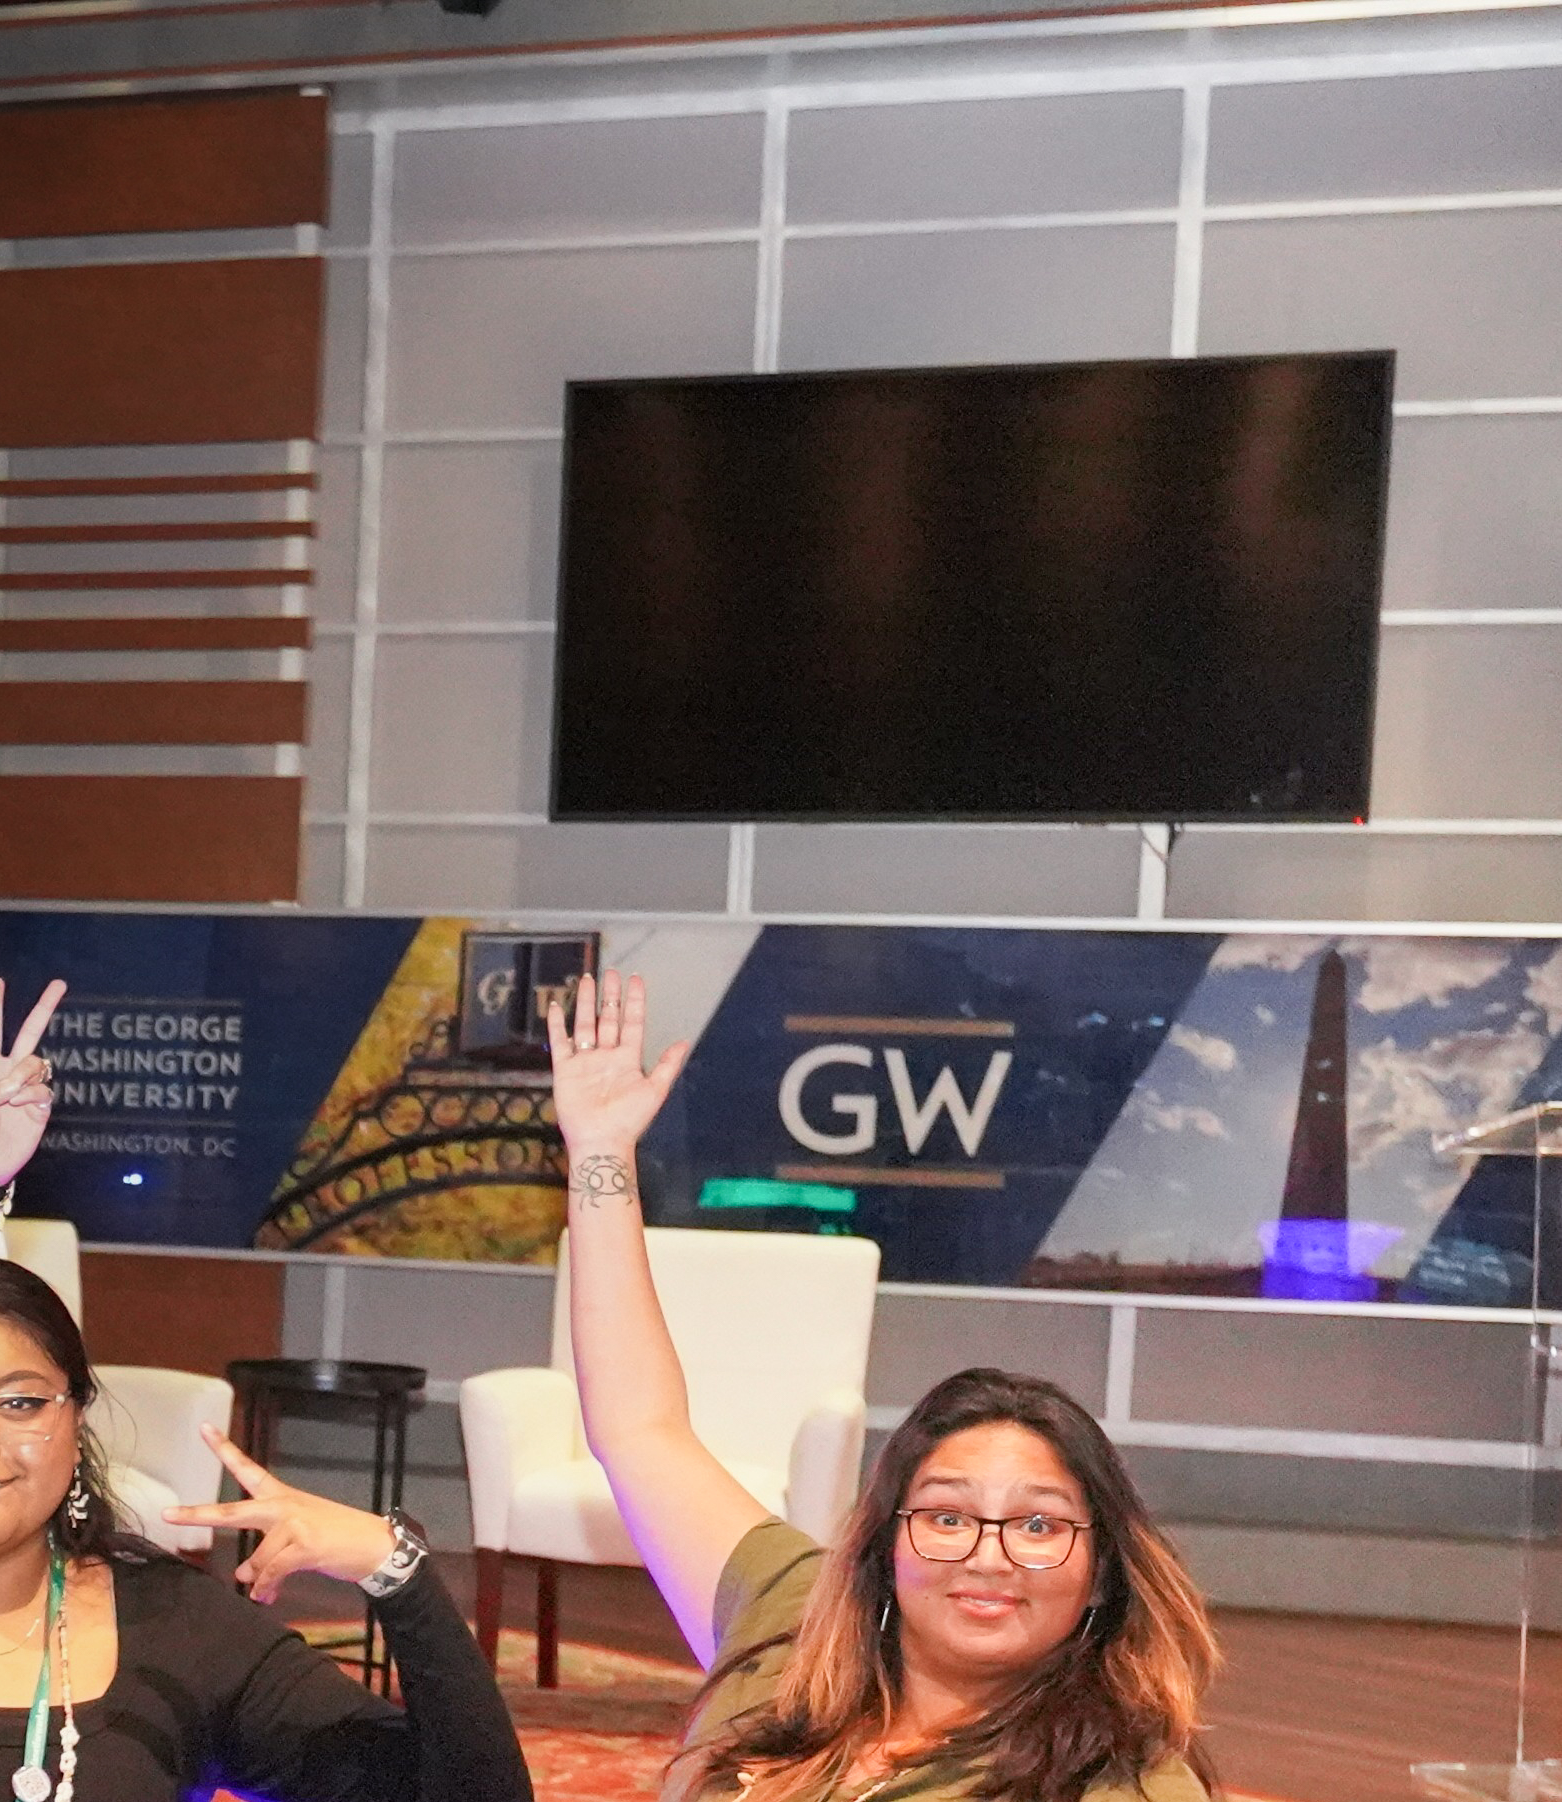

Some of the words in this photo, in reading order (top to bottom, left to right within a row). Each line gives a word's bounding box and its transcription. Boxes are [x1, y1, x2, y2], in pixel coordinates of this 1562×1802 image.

[47, 1011, 104, 1039] THE
[111, 1013, 242, 1042] GEORGE
[41, 1047, 242, 1076] WASHINGTON
[778, 1043, 1013, 1156] GW
[202, 1136, 237, 1157] DC
